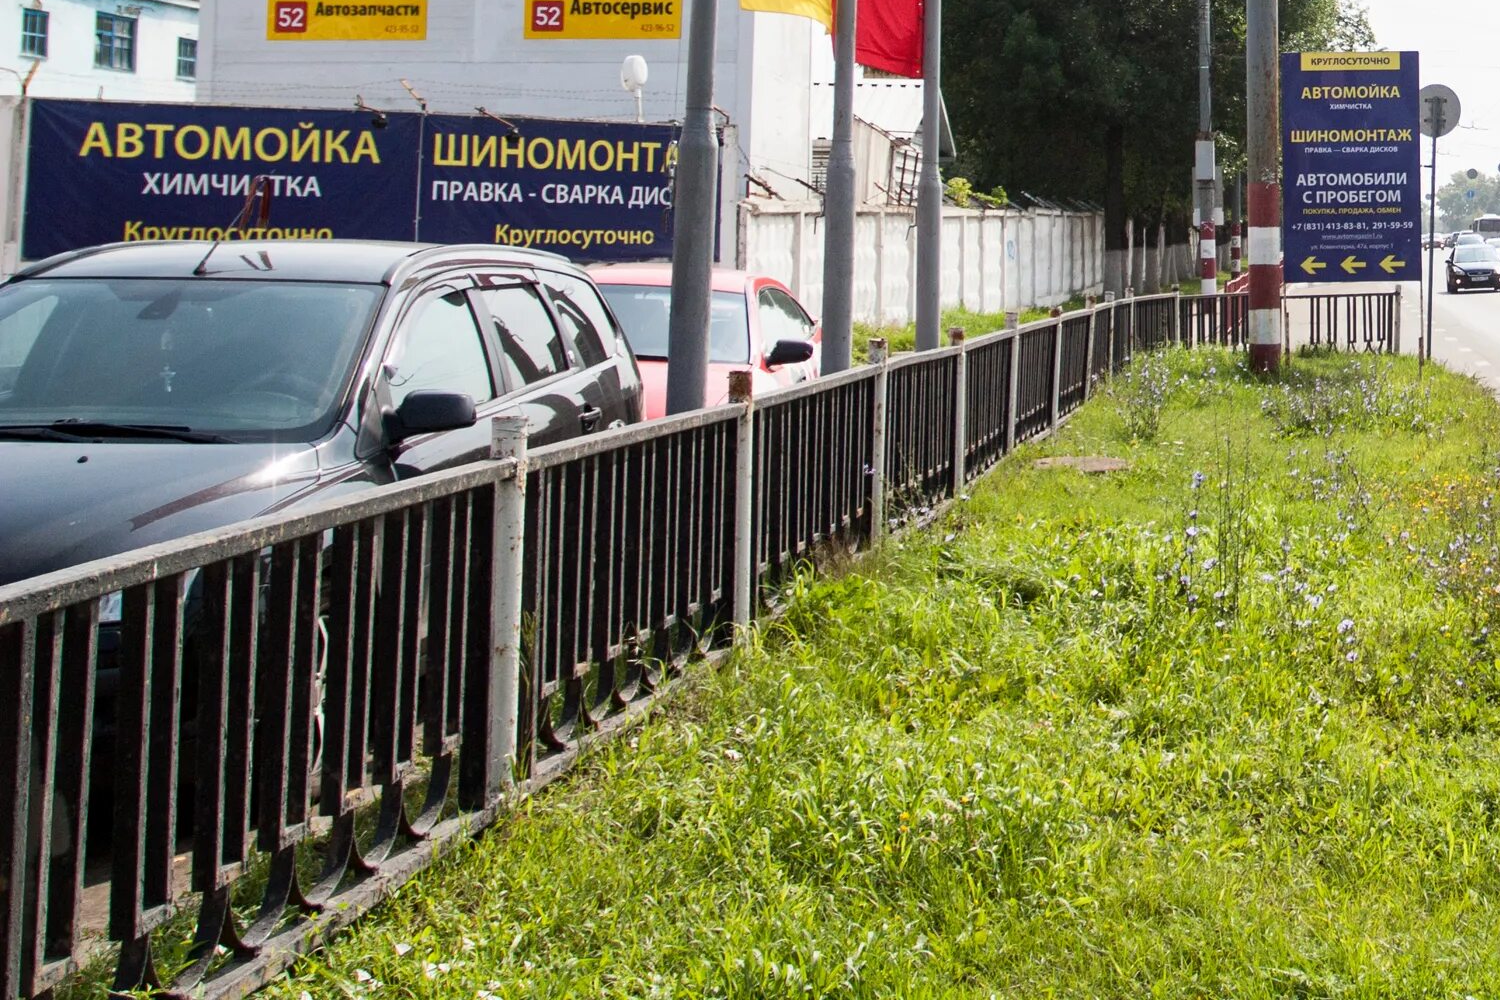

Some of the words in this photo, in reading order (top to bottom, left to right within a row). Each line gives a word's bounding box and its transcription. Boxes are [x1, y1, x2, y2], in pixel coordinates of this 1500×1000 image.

[277, 7, 304, 28] 52
[314, 2, 420, 17] Автозапчасти
[535, 6, 561, 26] 52
[1311, 57, 1391, 66] КРУГЛОСУТОЧНО
[1301, 84, 1401, 100] АВТОМОЙКА
[79, 121, 381, 164] АВТОМОЙКА
[1290, 128, 1412, 143] ШИНОМОНТАЖ
[433, 132, 679, 173] ШИНОМОНТА
[1296, 172, 1407, 186] АВТОМОБИЛИ
[432, 180, 523, 203] ПРАВКА
[541, 183, 624, 205] СВАРКА
[1302, 191, 1312, 204] С
[1316, 190, 1401, 203] ПРОБЕГОМ
[1303, 223, 1325, 231] (831)
[1372, 221, 1413, 229] 291-59-59
[494, 223, 655, 249] Круглосуточно
